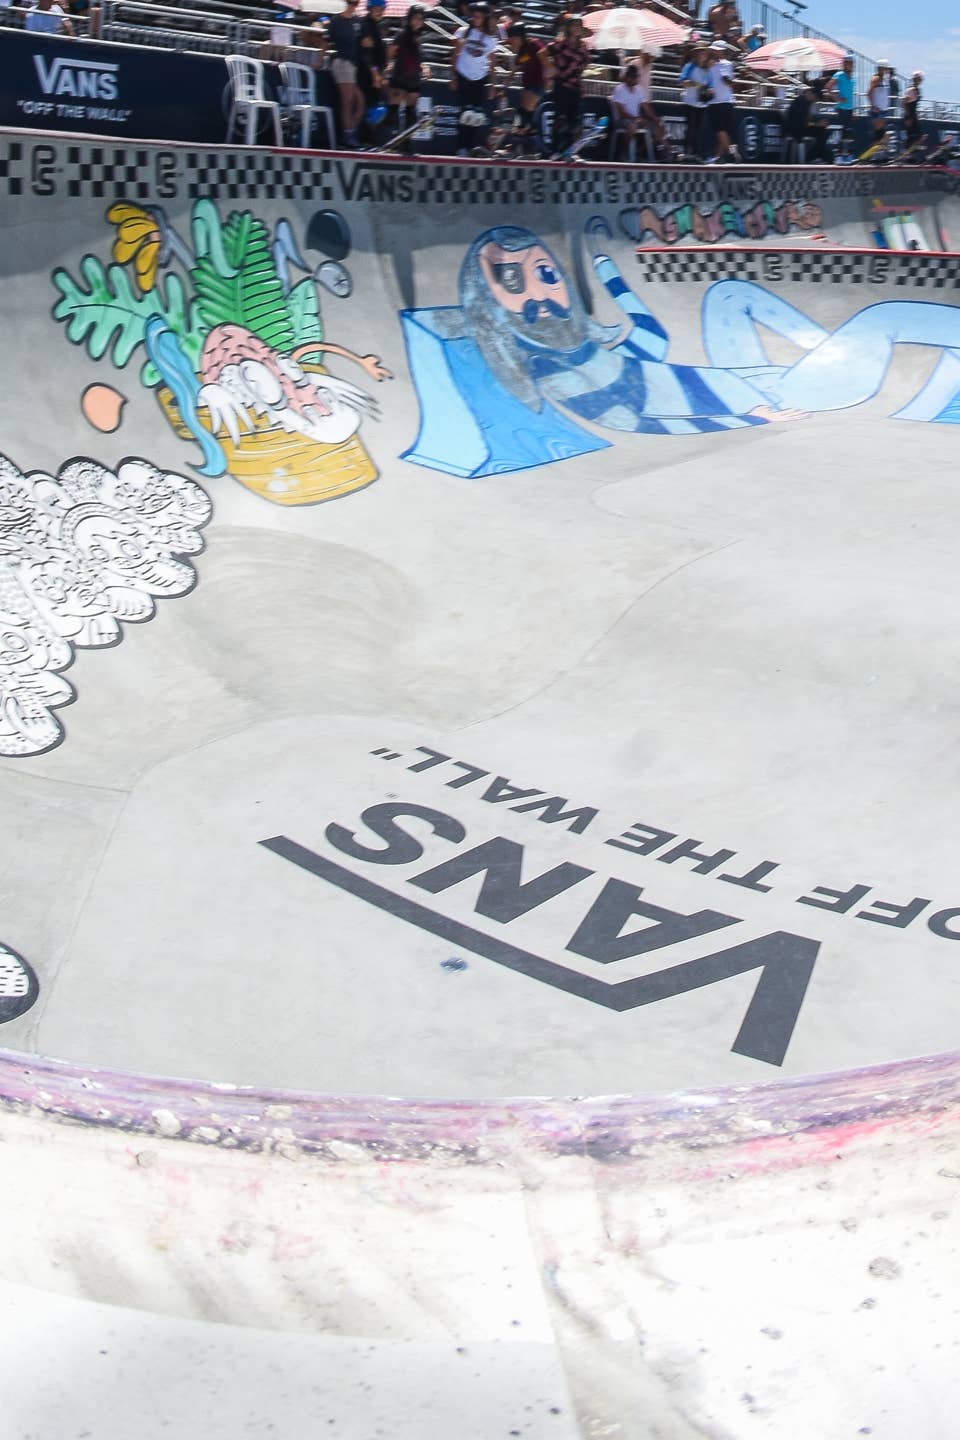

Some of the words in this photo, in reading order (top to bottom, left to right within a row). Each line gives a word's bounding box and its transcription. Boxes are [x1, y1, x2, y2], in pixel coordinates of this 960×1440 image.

[33, 54, 121, 101] VANS
[56, 104, 86, 118] THE
[336, 161, 416, 203] VANS
[370, 747, 600, 836] WALL"
[604, 823, 782, 893] THE
[256, 801, 822, 1068] VANS
